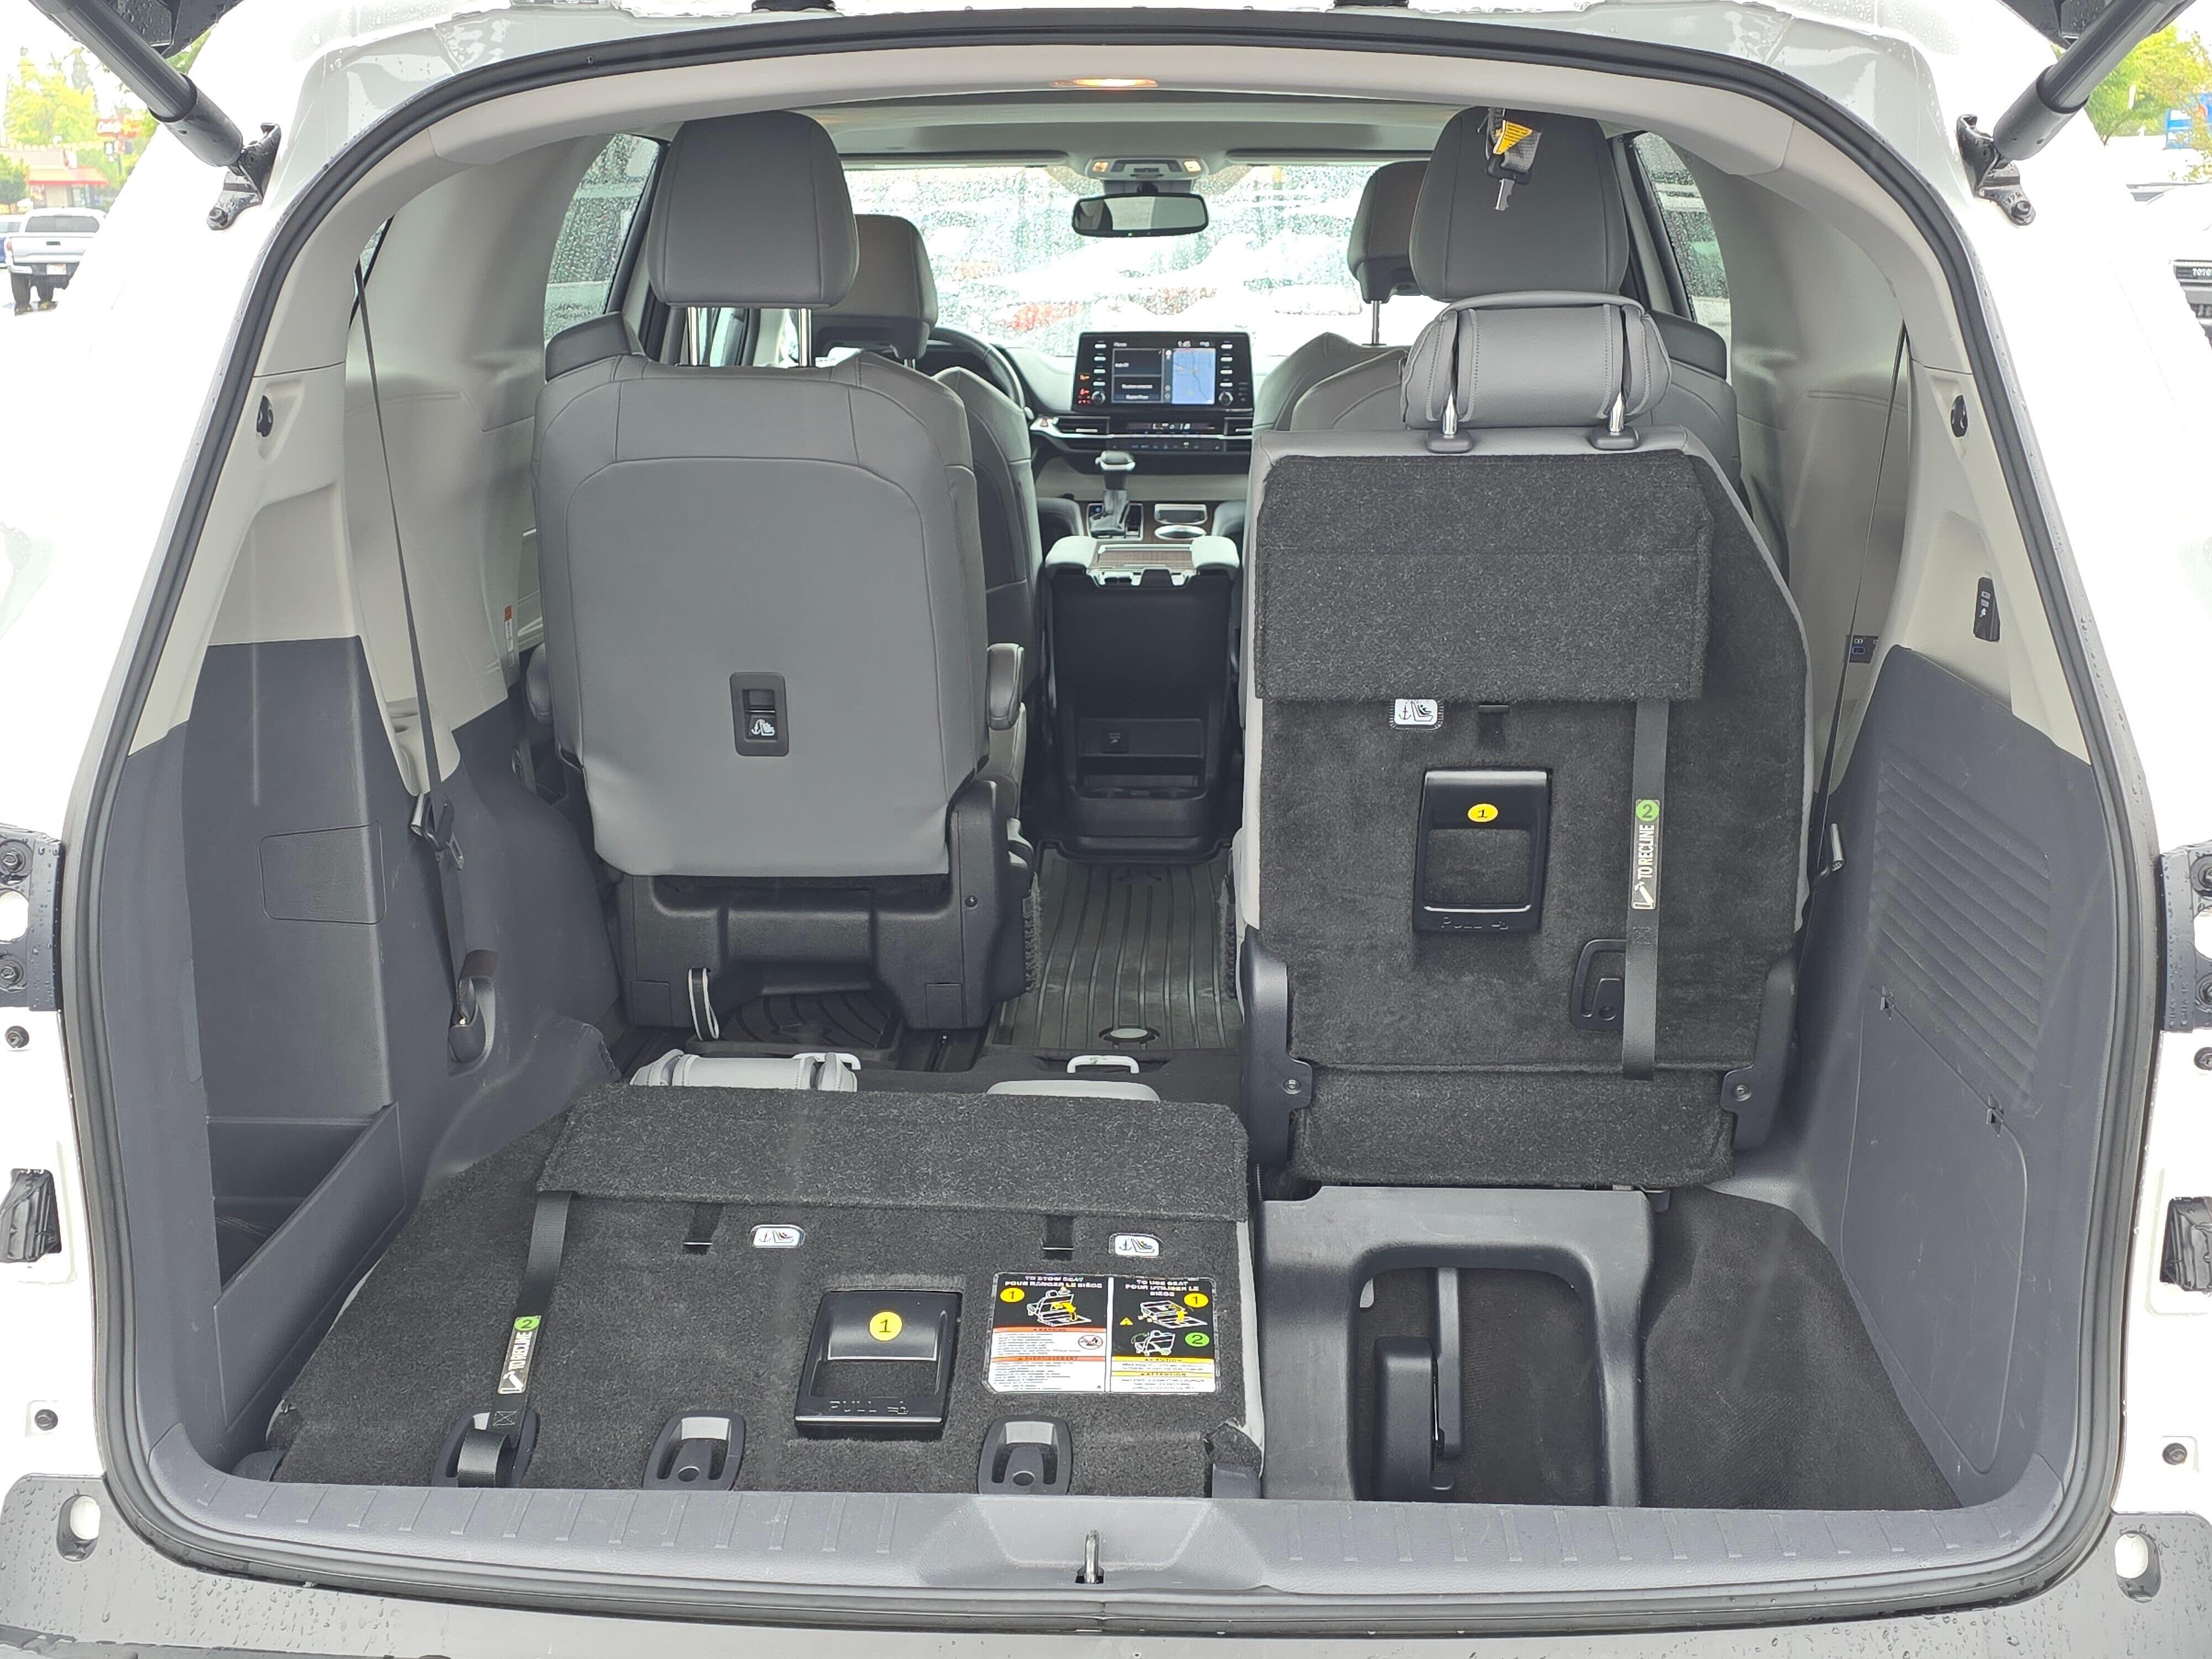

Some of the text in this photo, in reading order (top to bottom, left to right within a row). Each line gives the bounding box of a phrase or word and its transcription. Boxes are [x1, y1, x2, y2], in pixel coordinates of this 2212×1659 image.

[2192, 268, 2212, 276] TOYO
[1477, 809, 1488, 818] 1
[1642, 804, 1653, 818] 2
[1637, 824, 1655, 880] TO RECLINE
[1192, 1296, 1198, 1305] 1
[520, 1319, 533, 1329] 2
[879, 1319, 891, 1333] 1
[1192, 1334, 1203, 1344] 2
